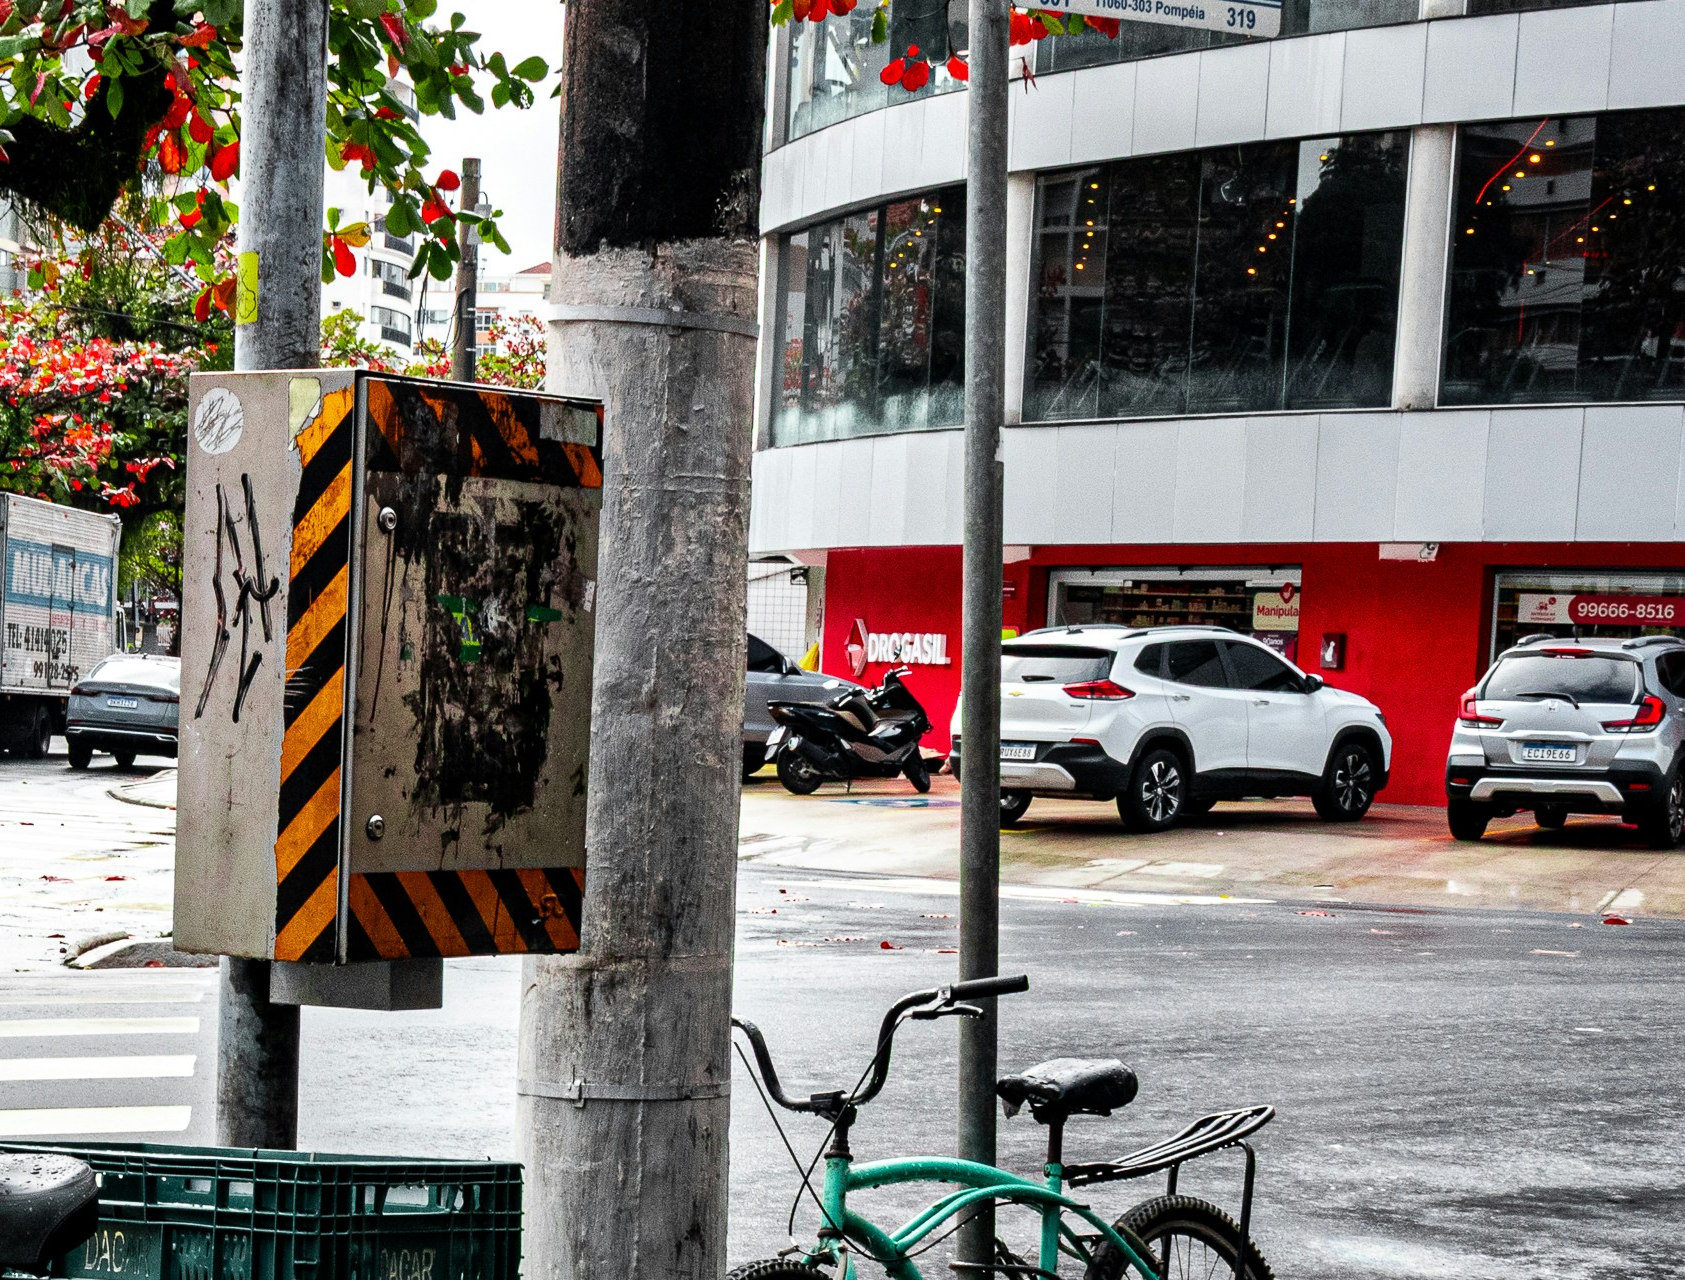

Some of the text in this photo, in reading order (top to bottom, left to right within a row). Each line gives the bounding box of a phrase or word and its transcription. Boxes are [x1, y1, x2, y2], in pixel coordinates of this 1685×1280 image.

[1155, 4, 1205, 21] Pompéia
[1226, 7, 1256, 30] 319
[1256, 604, 1299, 619] Manipula
[1577, 602, 1675, 620] 99666-8516
[7, 622, 22, 650] TEL:
[867, 631, 949, 665] DROGASIL
